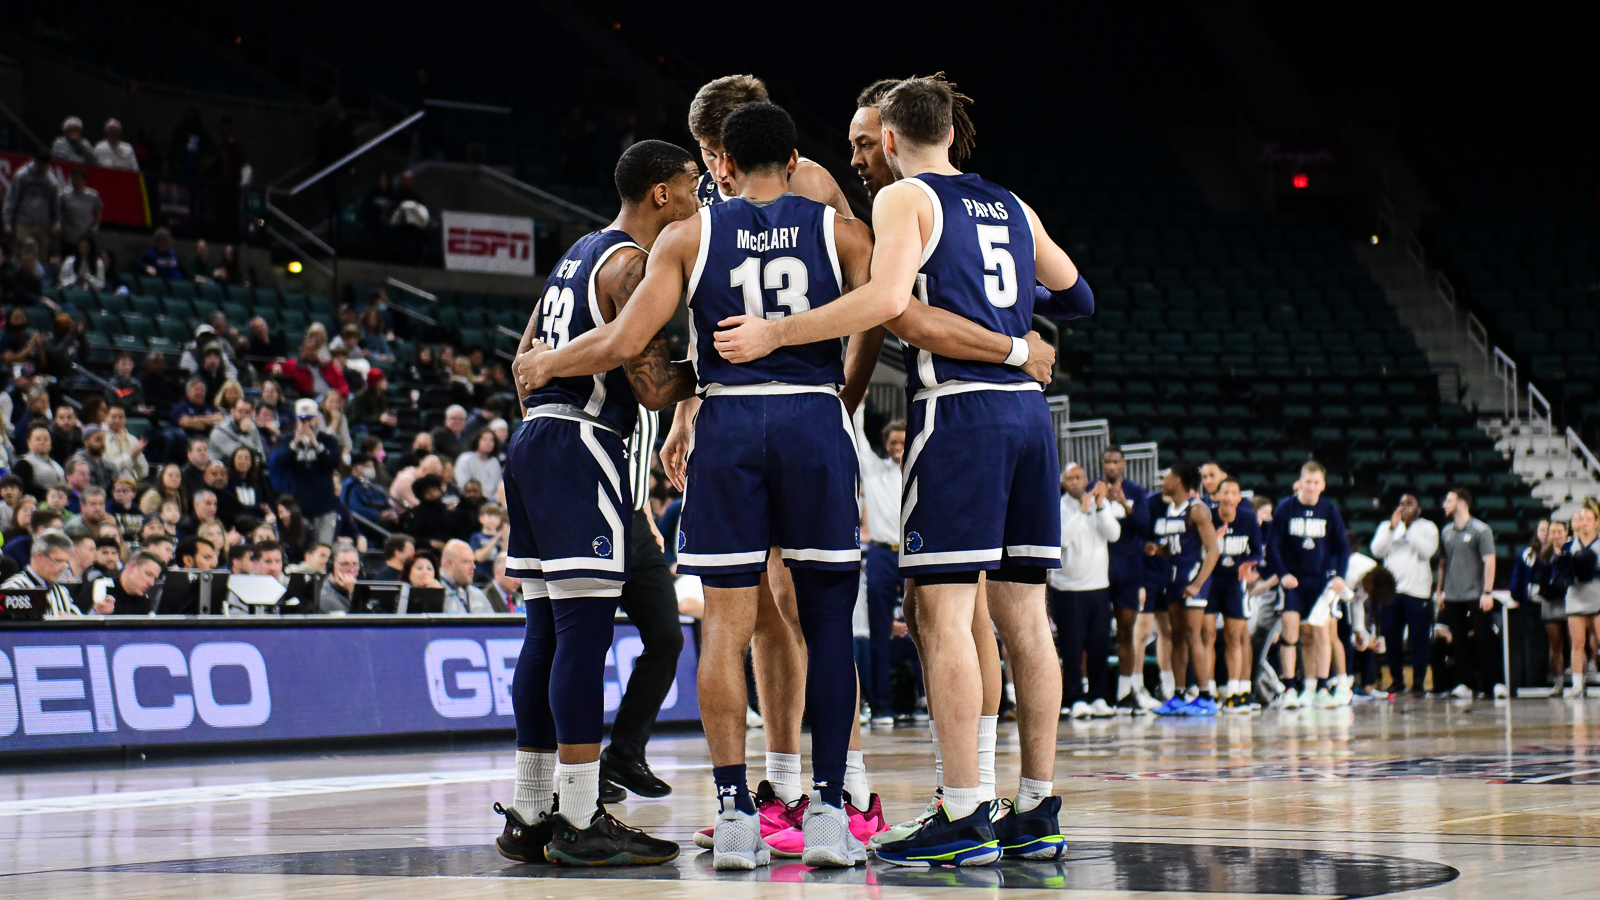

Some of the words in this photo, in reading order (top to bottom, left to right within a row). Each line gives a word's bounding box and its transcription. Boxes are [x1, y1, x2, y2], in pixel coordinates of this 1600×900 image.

[737, 226, 799, 252] McCLARY
[962, 198, 1009, 220] PAPAS
[448, 226, 530, 261] ESPN
[976, 224, 1018, 308] 5
[542, 285, 575, 350] 33
[730, 256, 811, 320] 13
[0, 642, 272, 737] EICO
